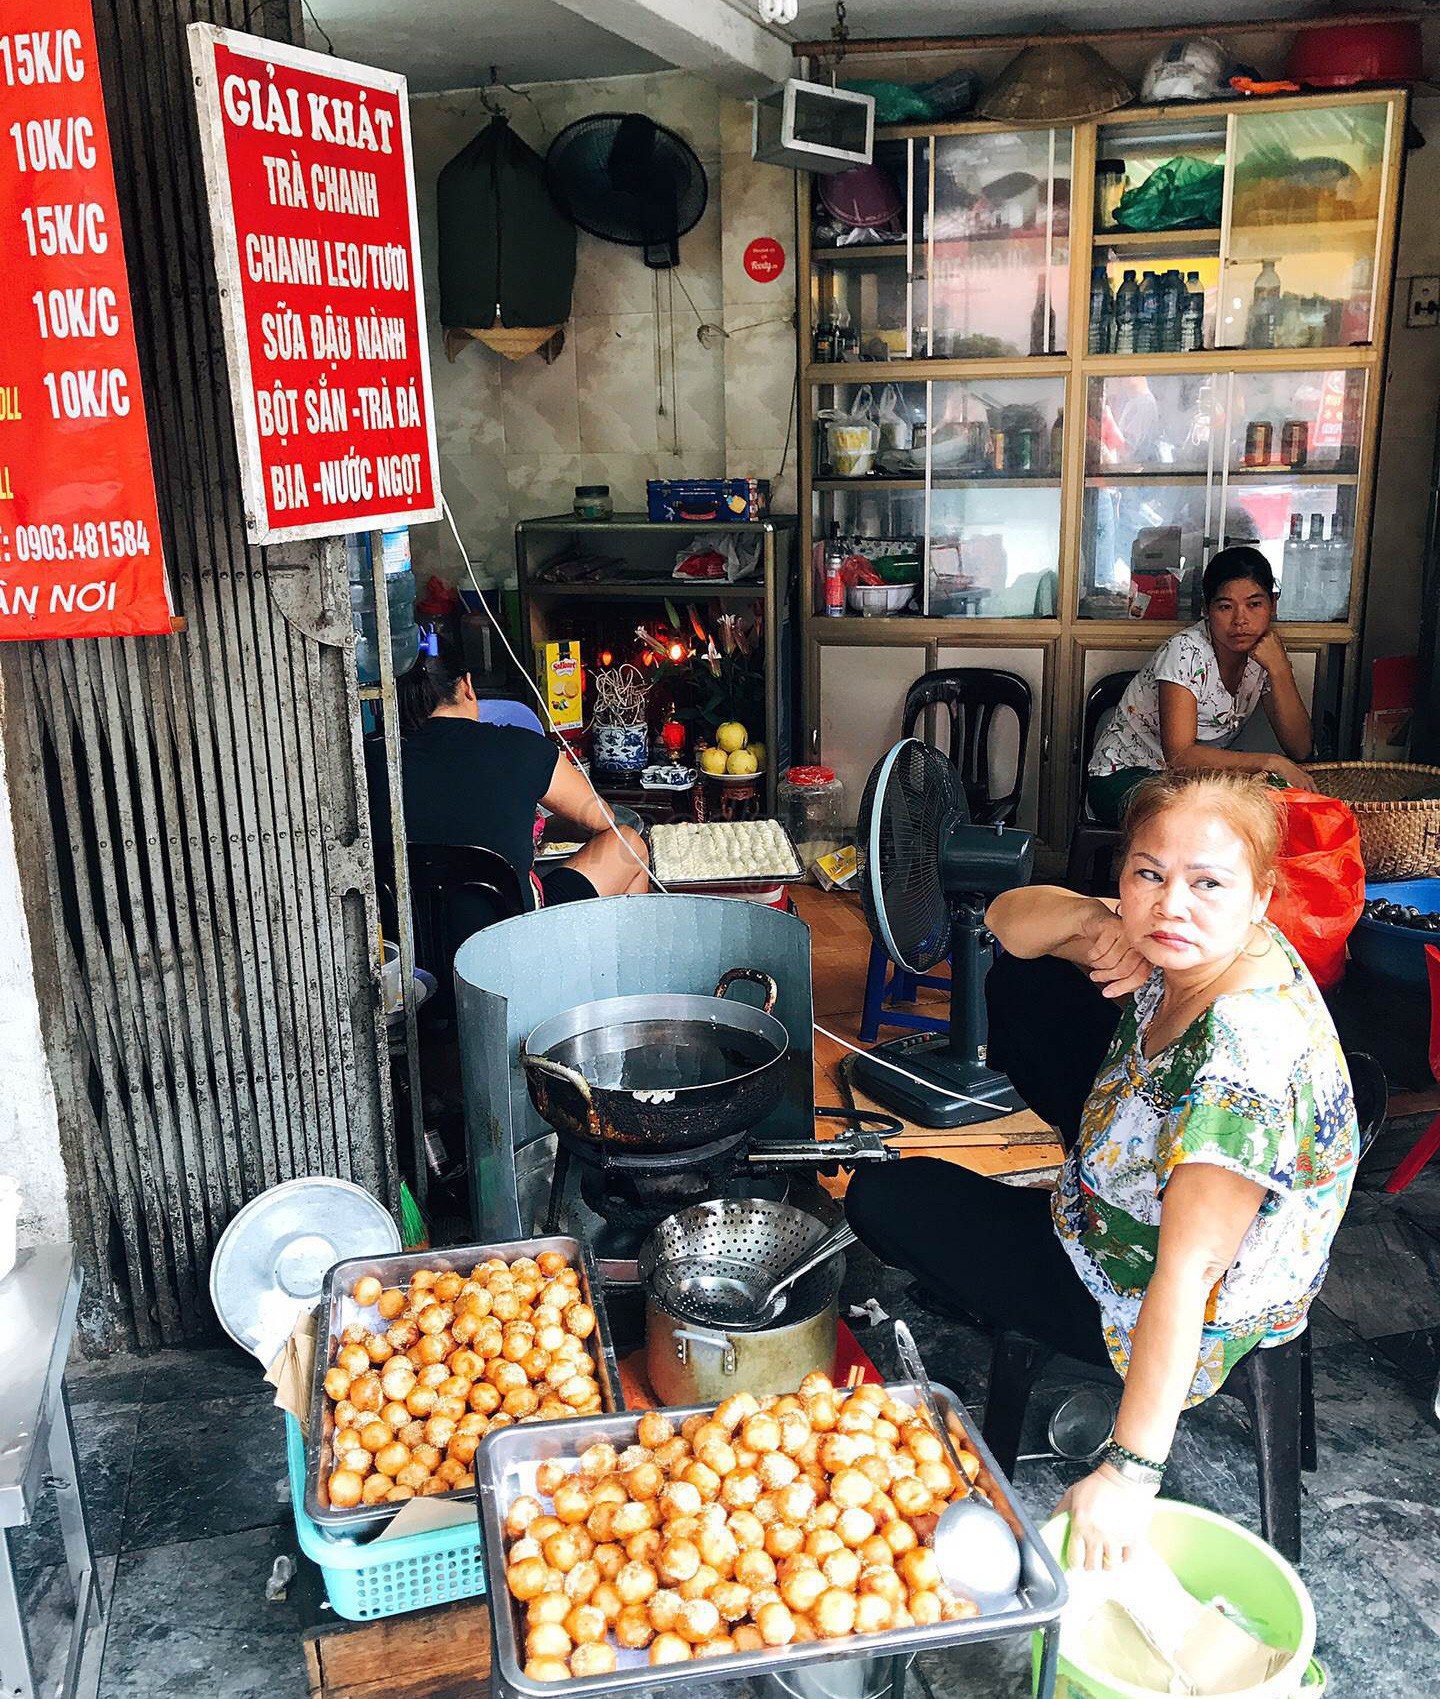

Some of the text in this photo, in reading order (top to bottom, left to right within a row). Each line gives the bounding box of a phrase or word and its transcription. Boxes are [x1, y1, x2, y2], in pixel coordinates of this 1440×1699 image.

[0, 28, 84, 86] 15K/C
[223, 63, 393, 154] GIẢI KHÁT
[9, 117, 96, 172] 10K/C
[262, 149, 379, 218] TRÀ CHANH
[21, 203, 108, 256] 15K/C
[245, 233, 322, 286] CHANH
[32, 287, 119, 339] 10K/C
[261, 301, 407, 370] SỮA ĐẬU NÀNH
[43, 368, 130, 419] 10K/C
[257, 379, 299, 446] BỘT
[304, 373, 348, 434] SẮN
[396, 377, 421, 428] ĐÁ
[270, 464, 309, 511] BIA
[376, 454, 421, 504] NGỌT
[15, 520, 150, 562] 0903.481584
[50, 581, 116, 614] NƠI
